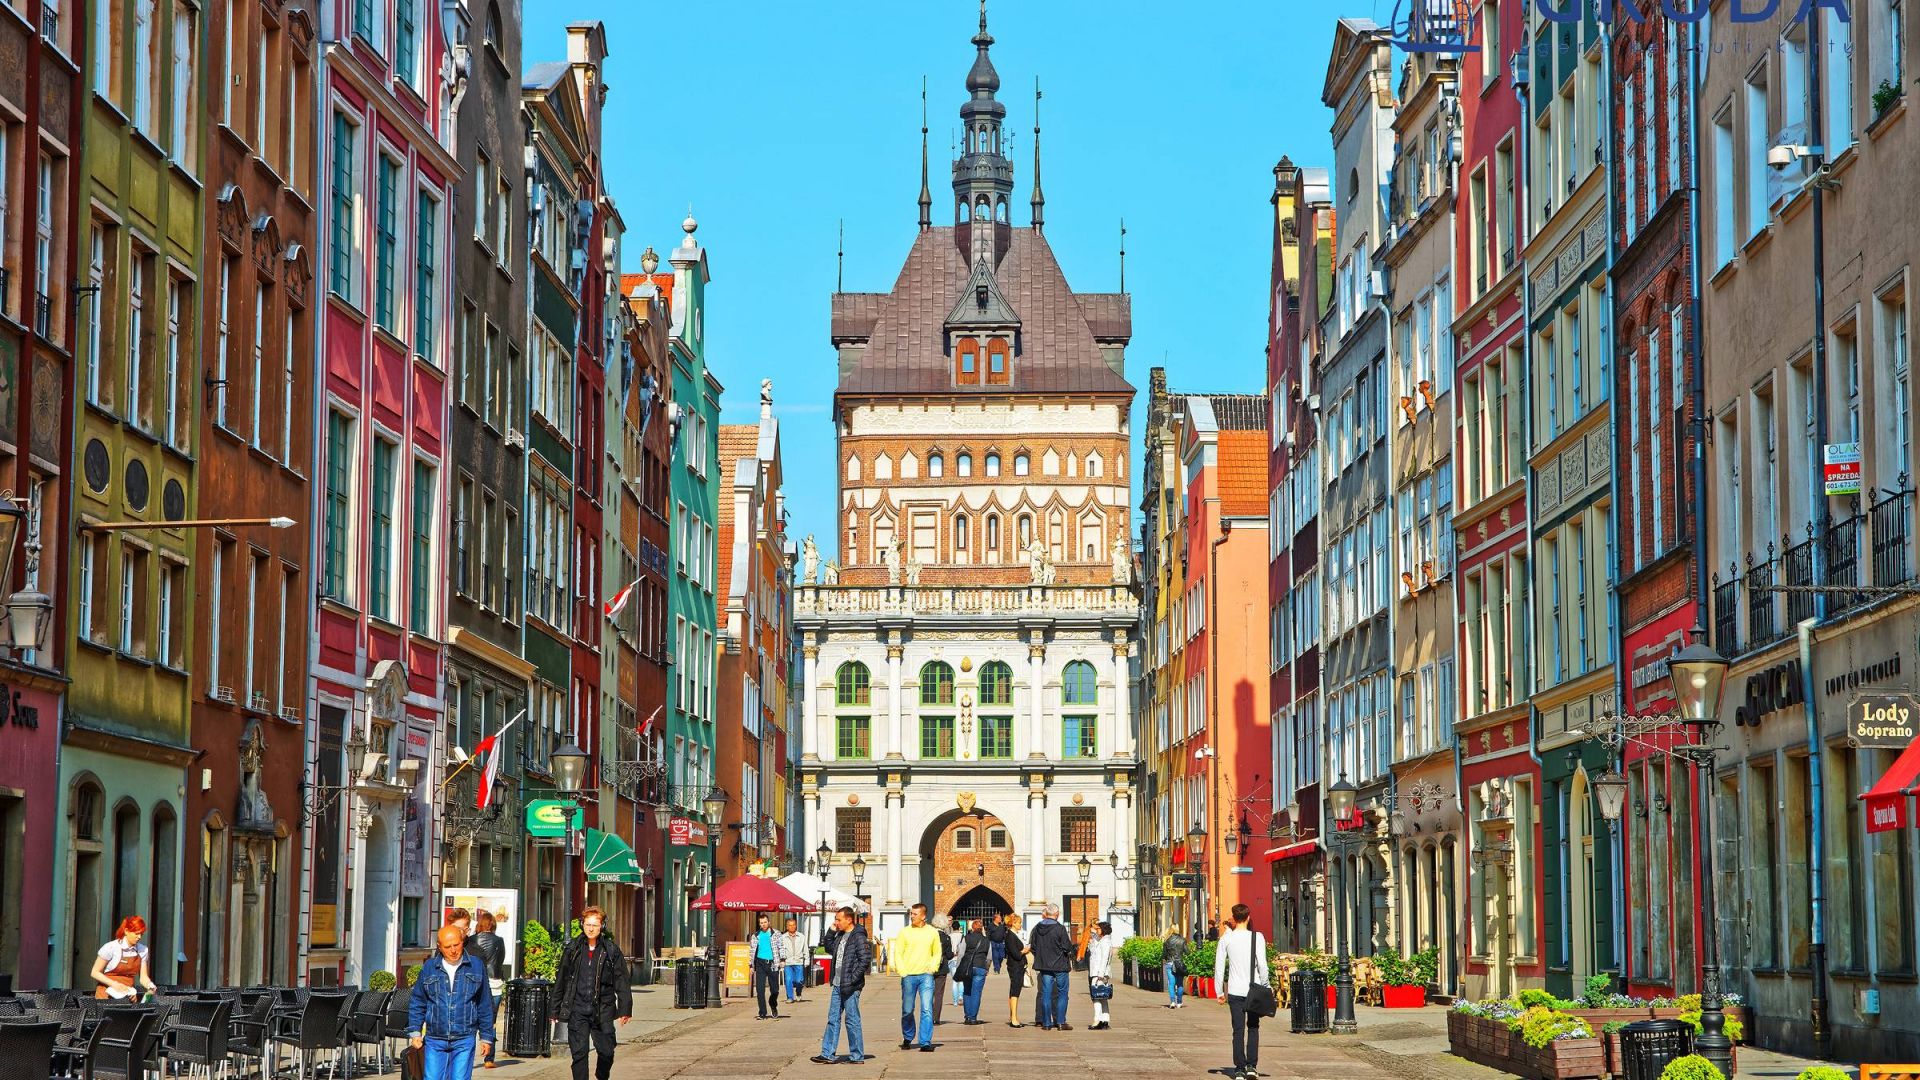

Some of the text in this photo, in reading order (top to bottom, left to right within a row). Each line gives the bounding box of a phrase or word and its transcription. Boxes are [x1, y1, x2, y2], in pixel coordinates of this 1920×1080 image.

[1828, 472, 1860, 481] SPRZEDA
[1825, 674, 1846, 696] LODY
[1863, 702, 1909, 725] Lody
[1857, 722, 1913, 739] Soprano
